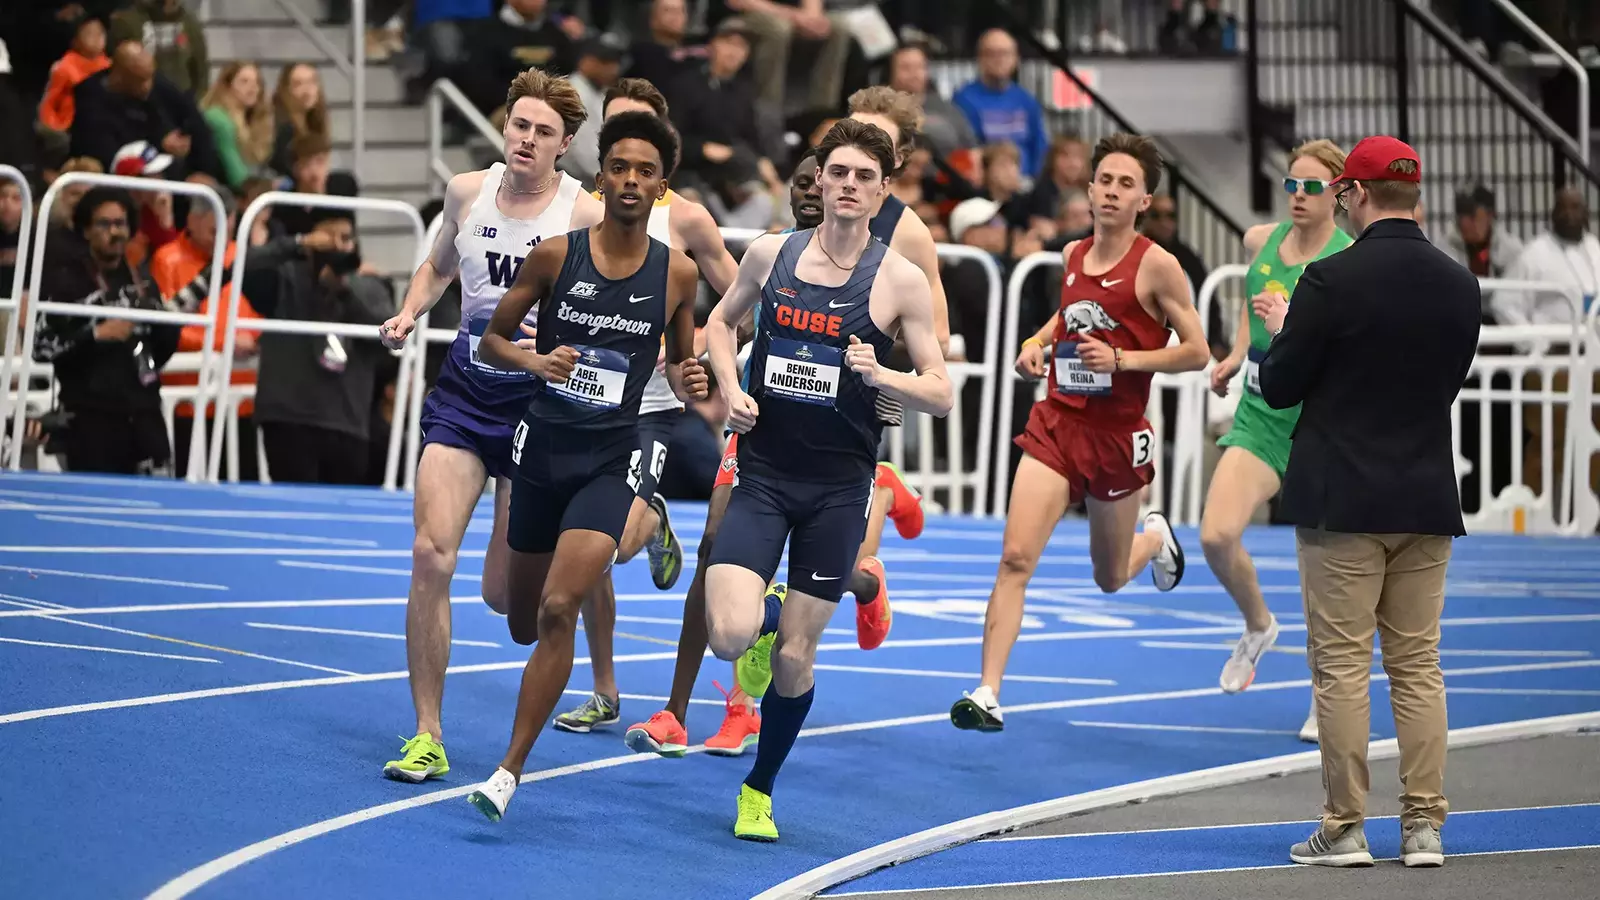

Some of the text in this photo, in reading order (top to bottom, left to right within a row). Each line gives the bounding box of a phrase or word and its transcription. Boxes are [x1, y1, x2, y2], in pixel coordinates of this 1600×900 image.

[485, 250, 527, 289] W
[569, 286, 600, 297] EAST
[575, 281, 597, 290] BIG
[777, 287, 797, 297] ACC
[557, 301, 652, 335] Georgetown
[576, 368, 599, 382] ABEL
[786, 363, 817, 377] BENNE
[1070, 372, 1095, 384] REINA
[565, 377, 605, 397] TEFFRA
[769, 372, 831, 394] ANDERSON
[1137, 433, 1150, 464] 3
[656, 448, 667, 477] 6
